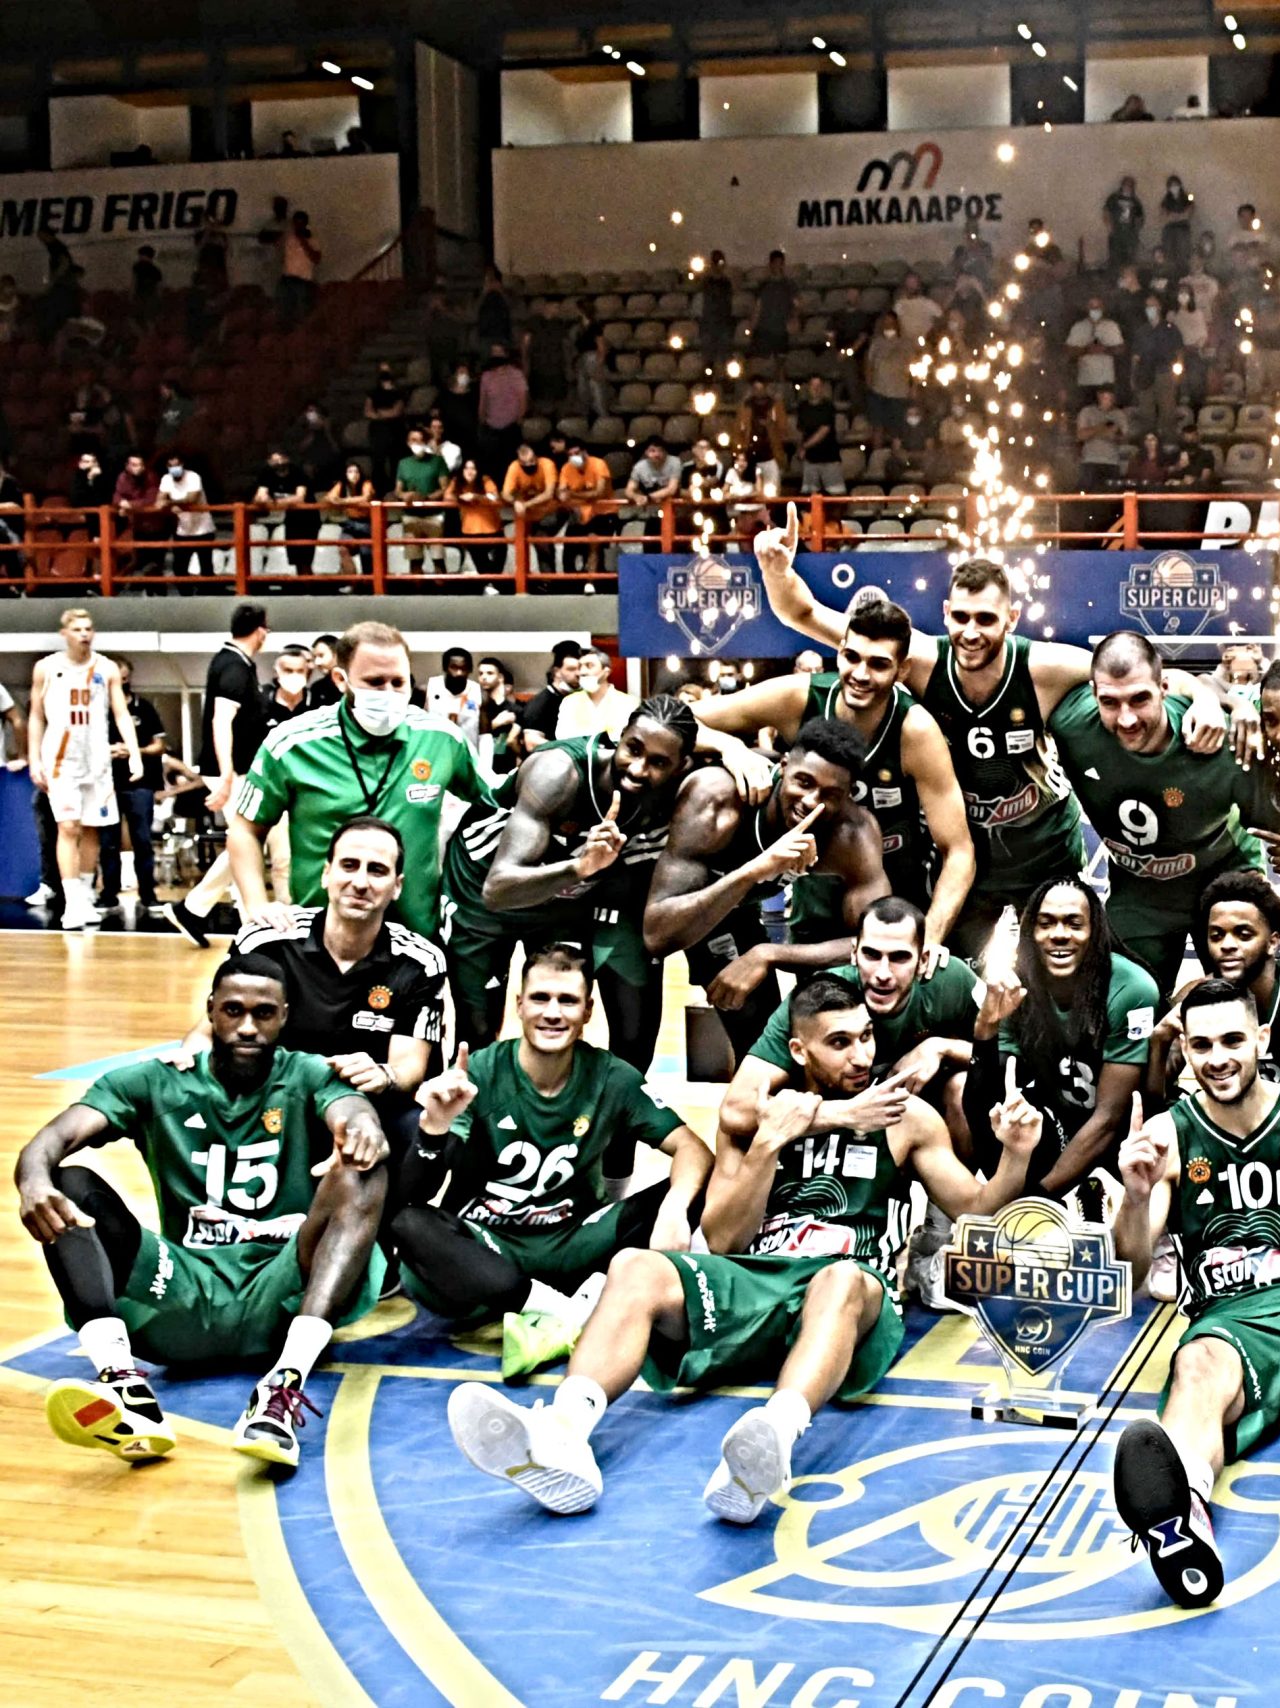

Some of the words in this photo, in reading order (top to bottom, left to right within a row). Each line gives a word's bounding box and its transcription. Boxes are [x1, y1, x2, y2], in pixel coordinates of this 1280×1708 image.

[0, 196, 94, 237] MED
[102, 189, 239, 233] FRIGO
[797, 193, 1003, 228] ΜΠΑΚΑΛΑΡΟΣ
[1127, 588, 1183, 608] SUPER
[1186, 588, 1221, 608] CUP
[967, 727, 996, 759] 6
[1118, 799, 1159, 846] 9
[190, 1139, 281, 1211] 15
[485, 1140, 579, 1203] 26
[794, 1134, 841, 1178] 14
[1217, 1161, 1273, 1210] 10
[955, 1260, 1050, 1299] SUPER
[1056, 1270, 1115, 1304] CUP
[600, 1650, 875, 1708] HNC
